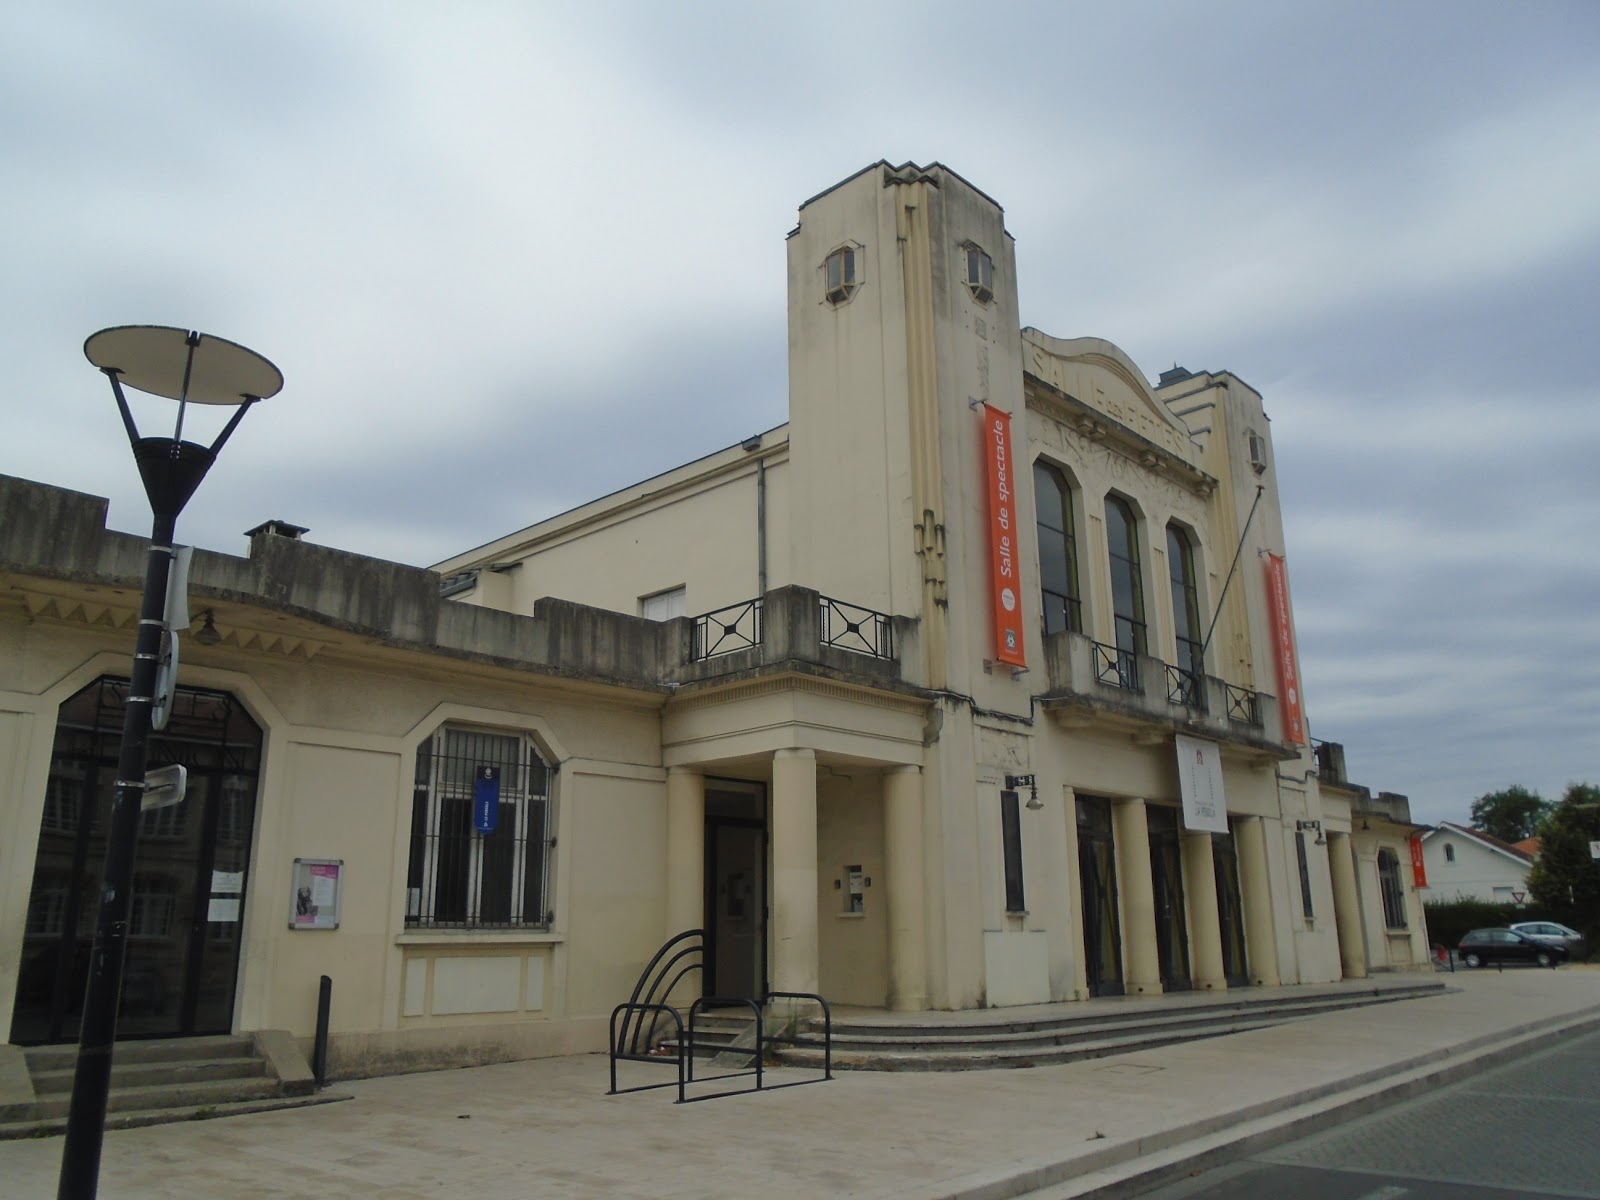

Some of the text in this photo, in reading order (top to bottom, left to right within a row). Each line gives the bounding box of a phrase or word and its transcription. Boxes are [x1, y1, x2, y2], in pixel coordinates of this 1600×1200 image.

[993, 420, 1012, 578] Salle de spectacle
[1274, 563, 1294, 680] Salle de spectacle
